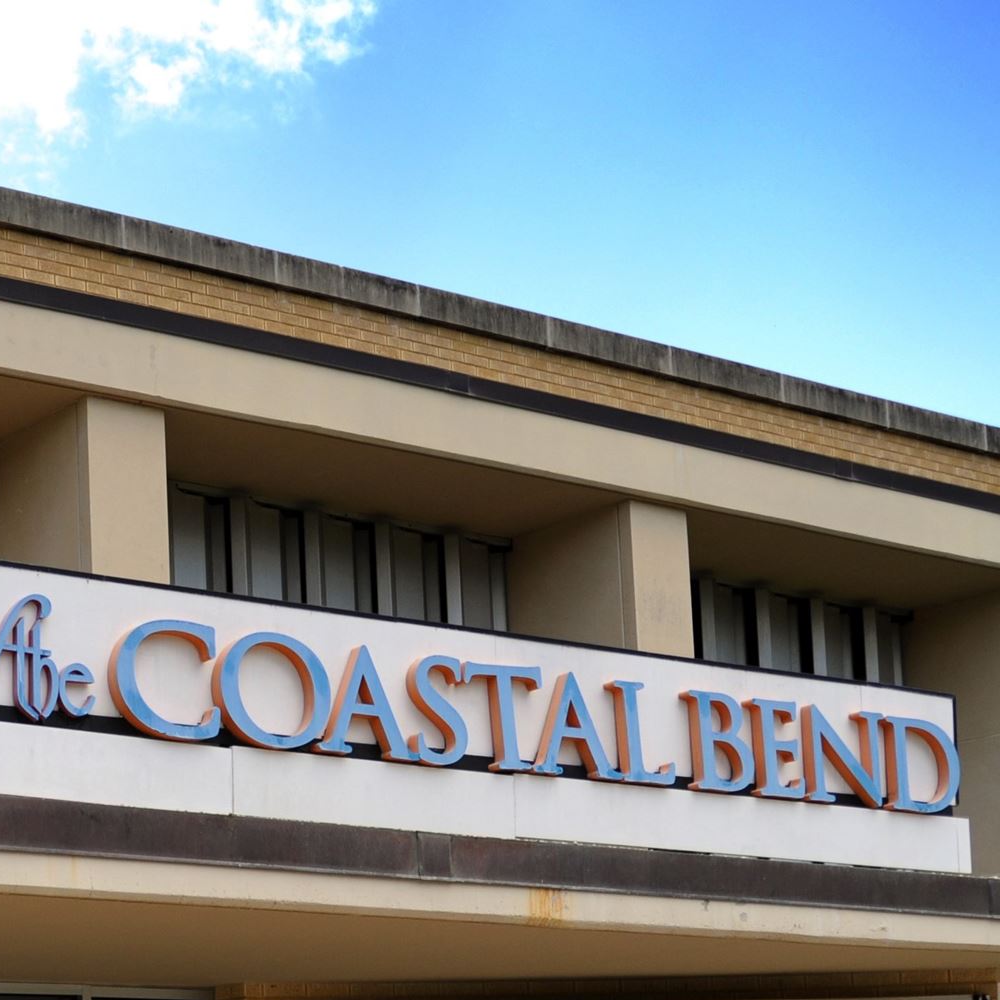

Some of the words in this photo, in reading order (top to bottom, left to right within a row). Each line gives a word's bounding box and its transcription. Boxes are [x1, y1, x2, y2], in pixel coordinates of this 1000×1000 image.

[10, 616, 97, 722] the
[109, 618, 675, 786] COASTAL
[679, 689, 960, 813] BEND
